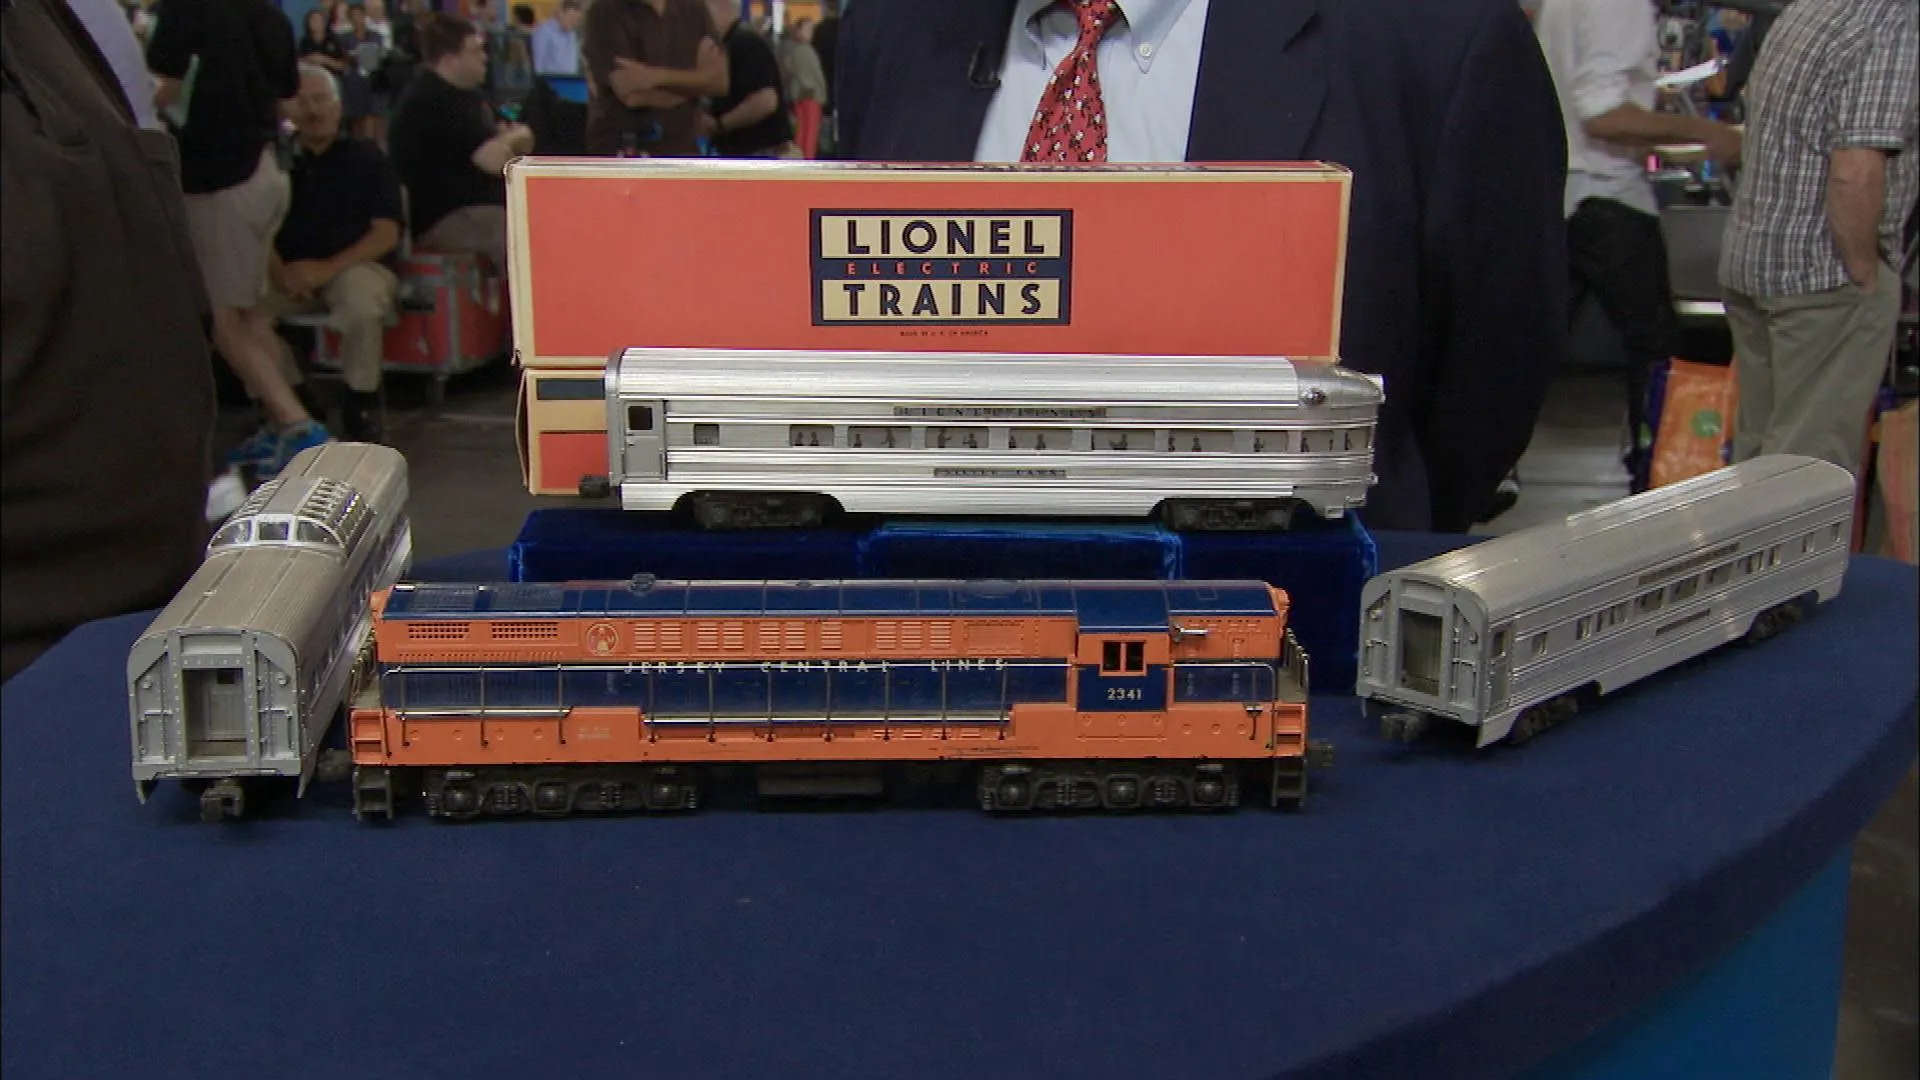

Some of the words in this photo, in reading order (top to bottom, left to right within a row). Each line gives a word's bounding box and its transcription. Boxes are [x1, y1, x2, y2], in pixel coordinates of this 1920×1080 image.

[847, 219, 1045, 255] LIONEL
[848, 262, 1038, 275] ELECTRIC
[843, 282, 1041, 316] TRAINS
[624, 661, 725, 674] JERSEY
[760, 659, 891, 673] CENTRAL
[931, 658, 1006, 672] LINES
[1107, 687, 1143, 700] 2341
